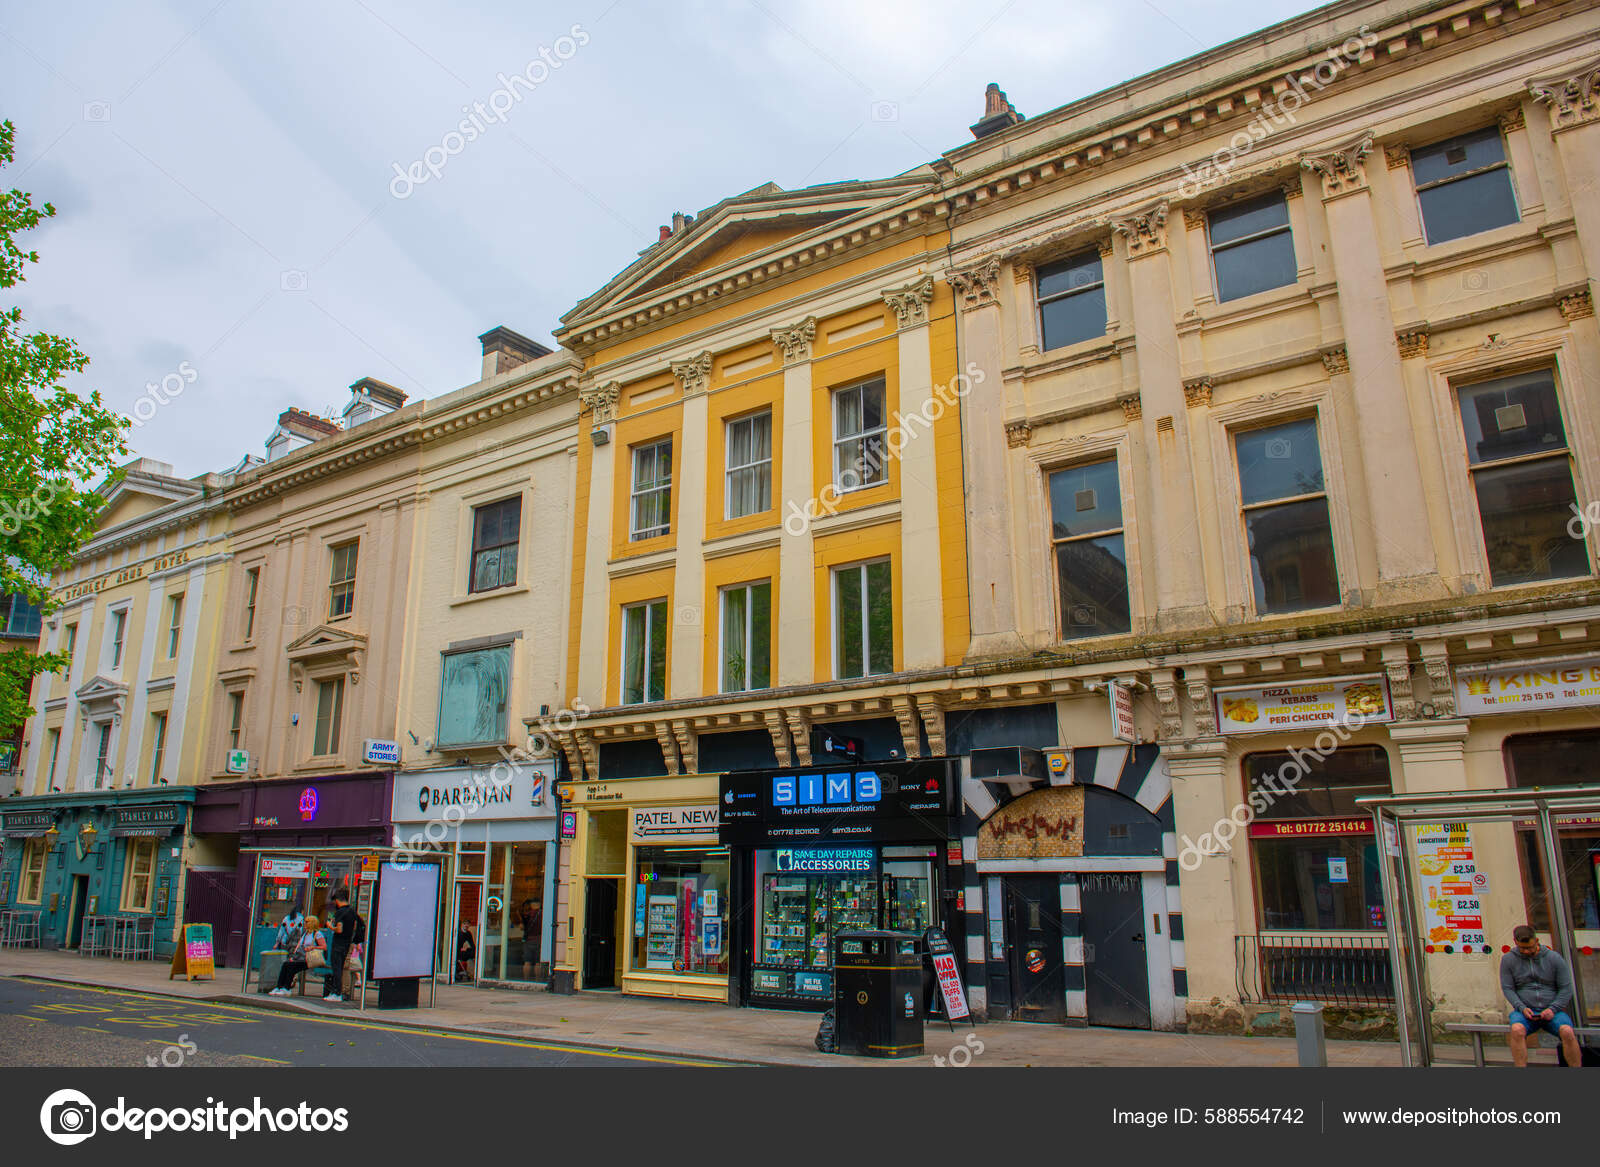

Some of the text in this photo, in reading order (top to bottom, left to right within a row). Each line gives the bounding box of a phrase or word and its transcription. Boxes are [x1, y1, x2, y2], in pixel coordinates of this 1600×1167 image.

[153, 552, 190, 572] HOTEL
[1499, 669, 1584, 691] KING
[1262, 684, 1336, 697] PIZZA BURGERS
[1281, 694, 1318, 705] KEBABS
[1264, 702, 1336, 716] FRIED CHICKEN
[1269, 711, 1334, 724] PERI CHICKEN
[371, 743, 395, 752] ARMY
[368, 751, 398, 761] STORES
[776, 776, 877, 802] SIM3
[432, 784, 513, 808] BARBAJAN
[120, 809, 175, 823] STANLEY ARMS
[780, 804, 876, 815] The Art of Telecommunications
[634, 811, 677, 826] PATEL
[1274, 821, 1366, 834] Tel: 01772 251414
[1416, 823, 1469, 838] KING GRILL
[794, 849, 873, 859] SAME DAY REPAIRS
[793, 860, 871, 871] ACCESSORIES
[1453, 864, 1476, 874] £2.50
[640, 872, 658, 882] open
[1457, 900, 1480, 910] £2.50
[1461, 934, 1485, 943] £2.50
[934, 957, 954, 972] MAD
[938, 970, 957, 981] OFFER
